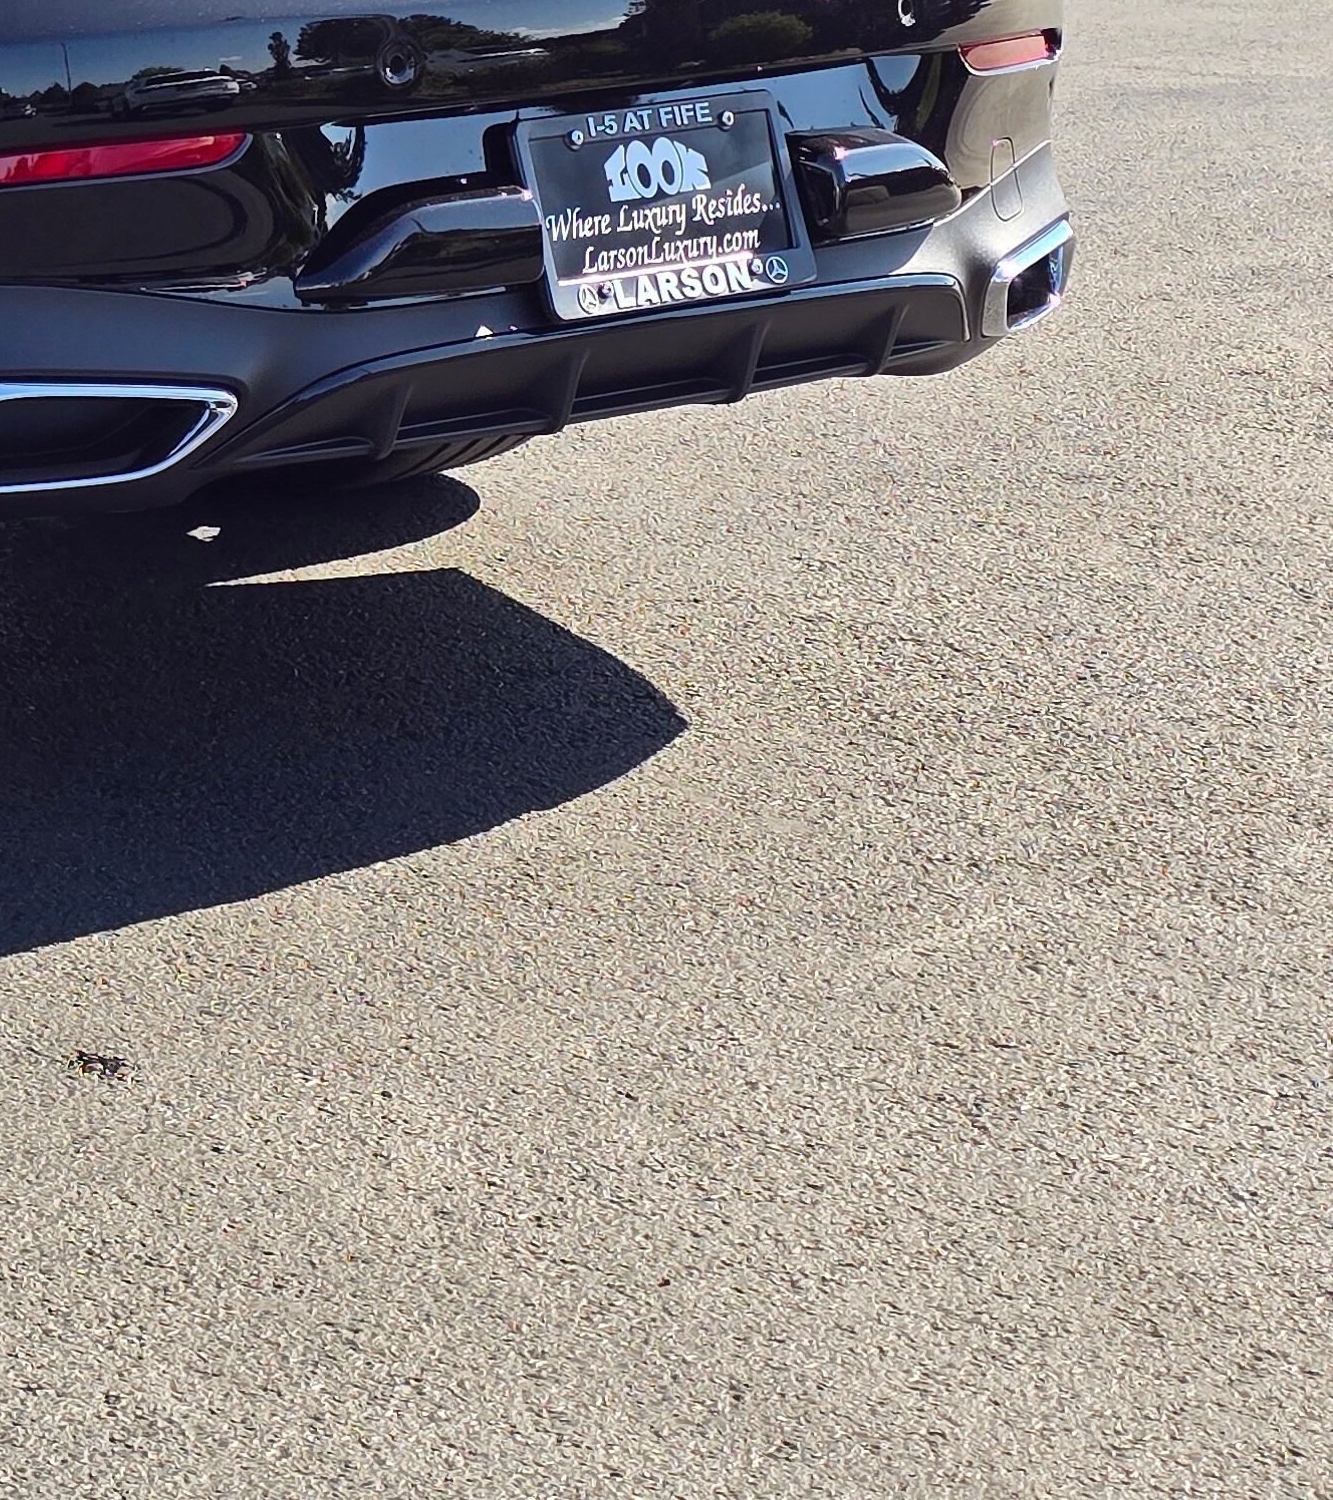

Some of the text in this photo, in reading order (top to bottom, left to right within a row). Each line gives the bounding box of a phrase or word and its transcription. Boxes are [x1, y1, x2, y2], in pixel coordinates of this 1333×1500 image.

[587, 102, 713, 137] I-5 AT FIFE
[604, 136, 711, 202] LOOK
[546, 184, 781, 242] Where Luxury Resides...
[582, 228, 761, 275] LarsonLuxury.com
[612, 259, 755, 309] LARSON
